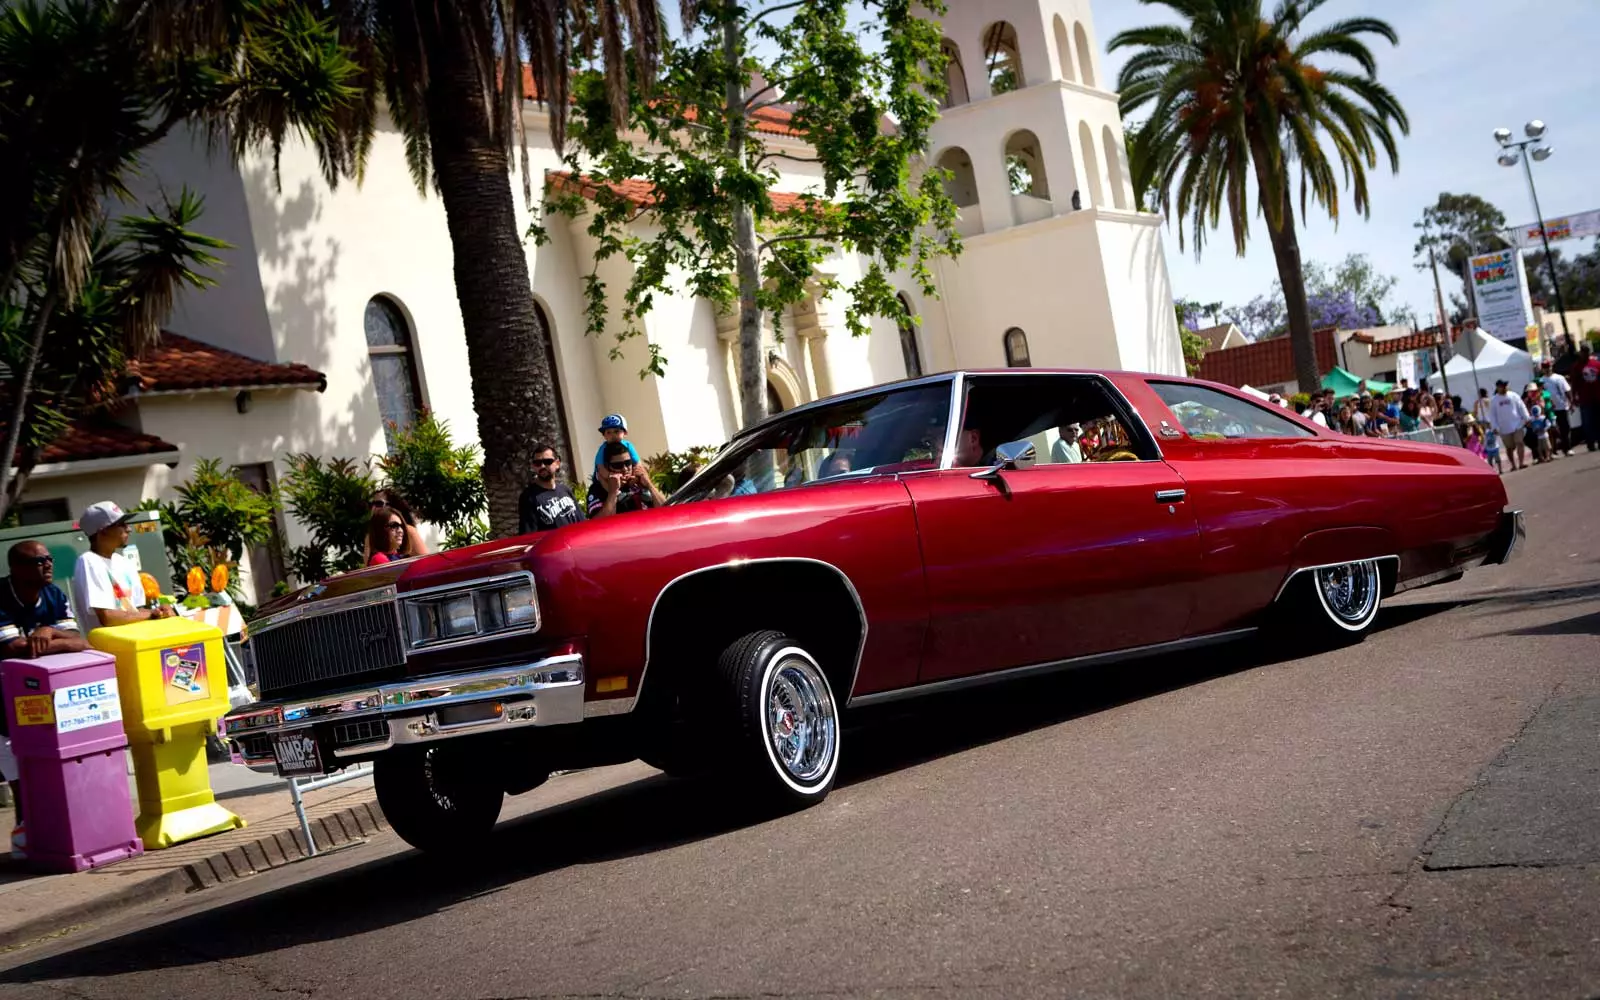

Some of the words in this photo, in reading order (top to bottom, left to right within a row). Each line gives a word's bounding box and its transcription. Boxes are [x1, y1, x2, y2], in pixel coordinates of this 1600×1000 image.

[67, 683, 107, 701] FREE
[282, 761, 305, 770] NATIONAL
[305, 759, 317, 768] CITY
